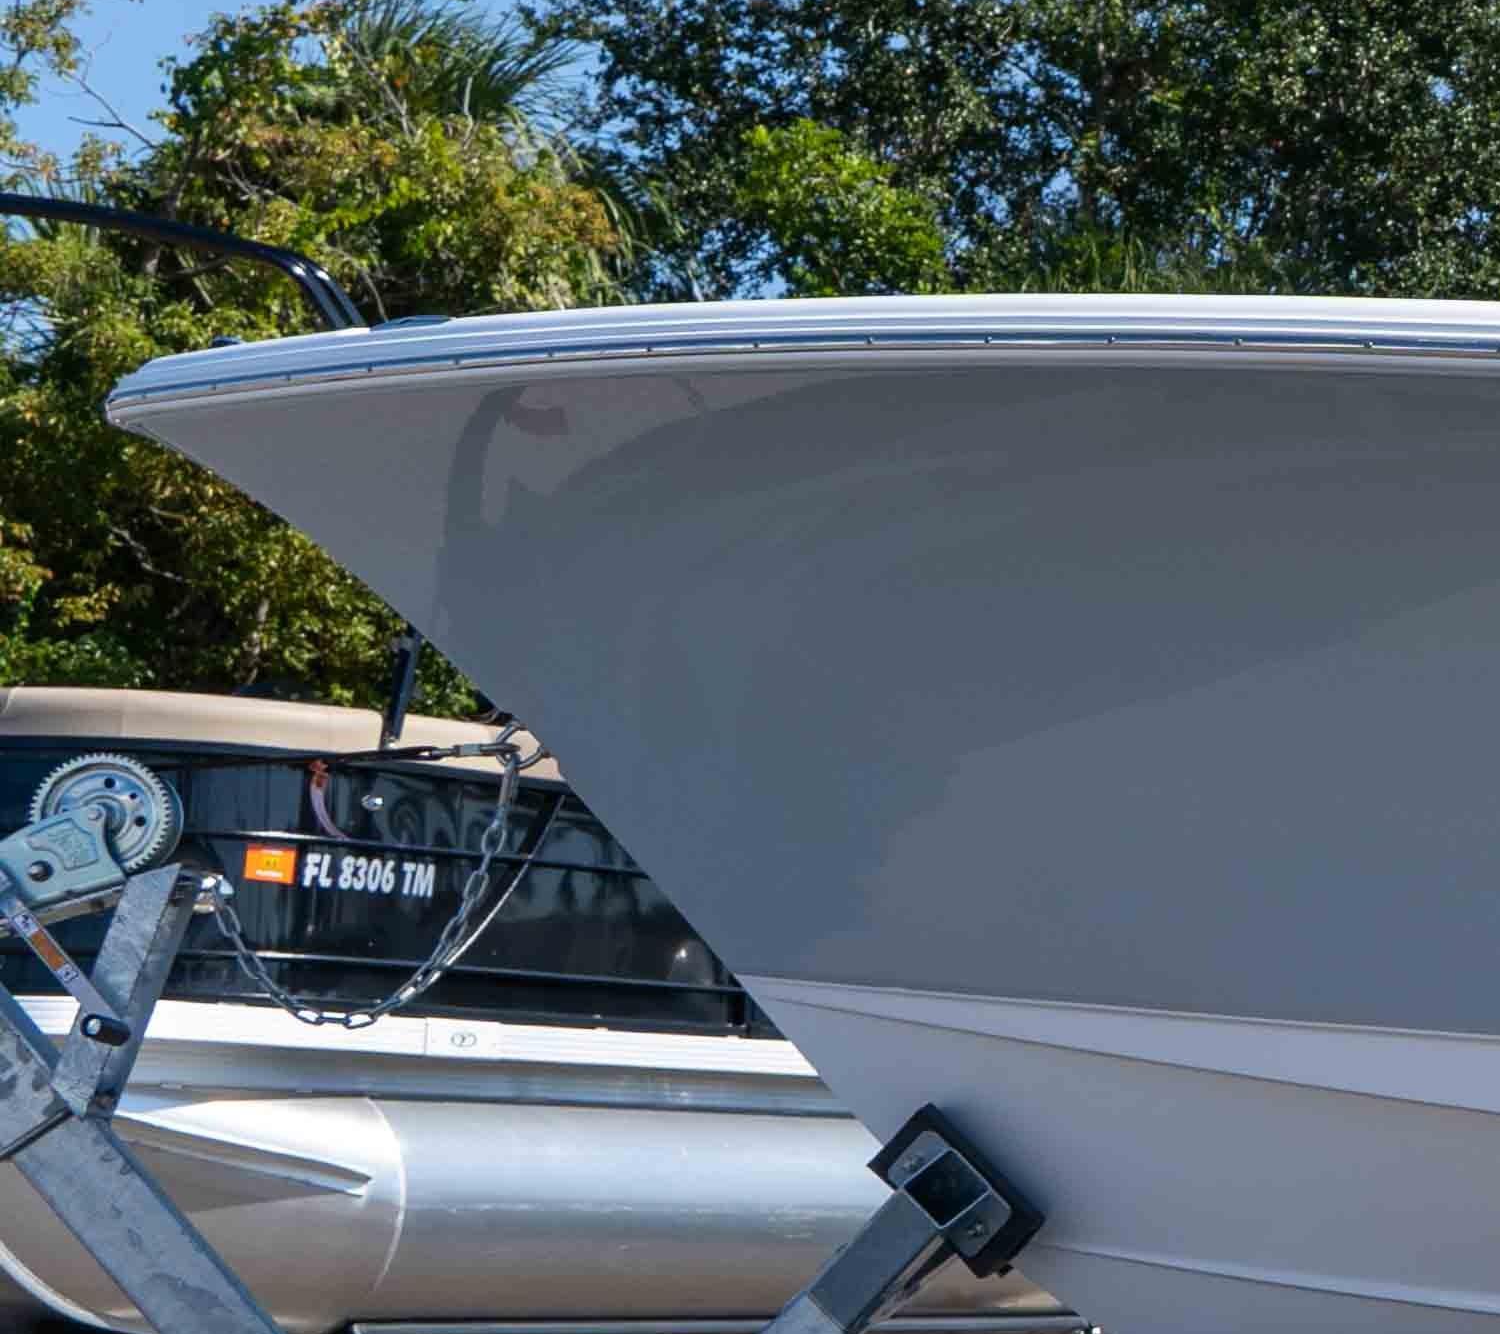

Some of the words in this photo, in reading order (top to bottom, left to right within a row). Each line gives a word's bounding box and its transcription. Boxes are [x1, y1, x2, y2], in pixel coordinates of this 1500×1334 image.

[302, 852, 332, 888] FL
[338, 855, 395, 894] 8306
[402, 861, 436, 898] TM
